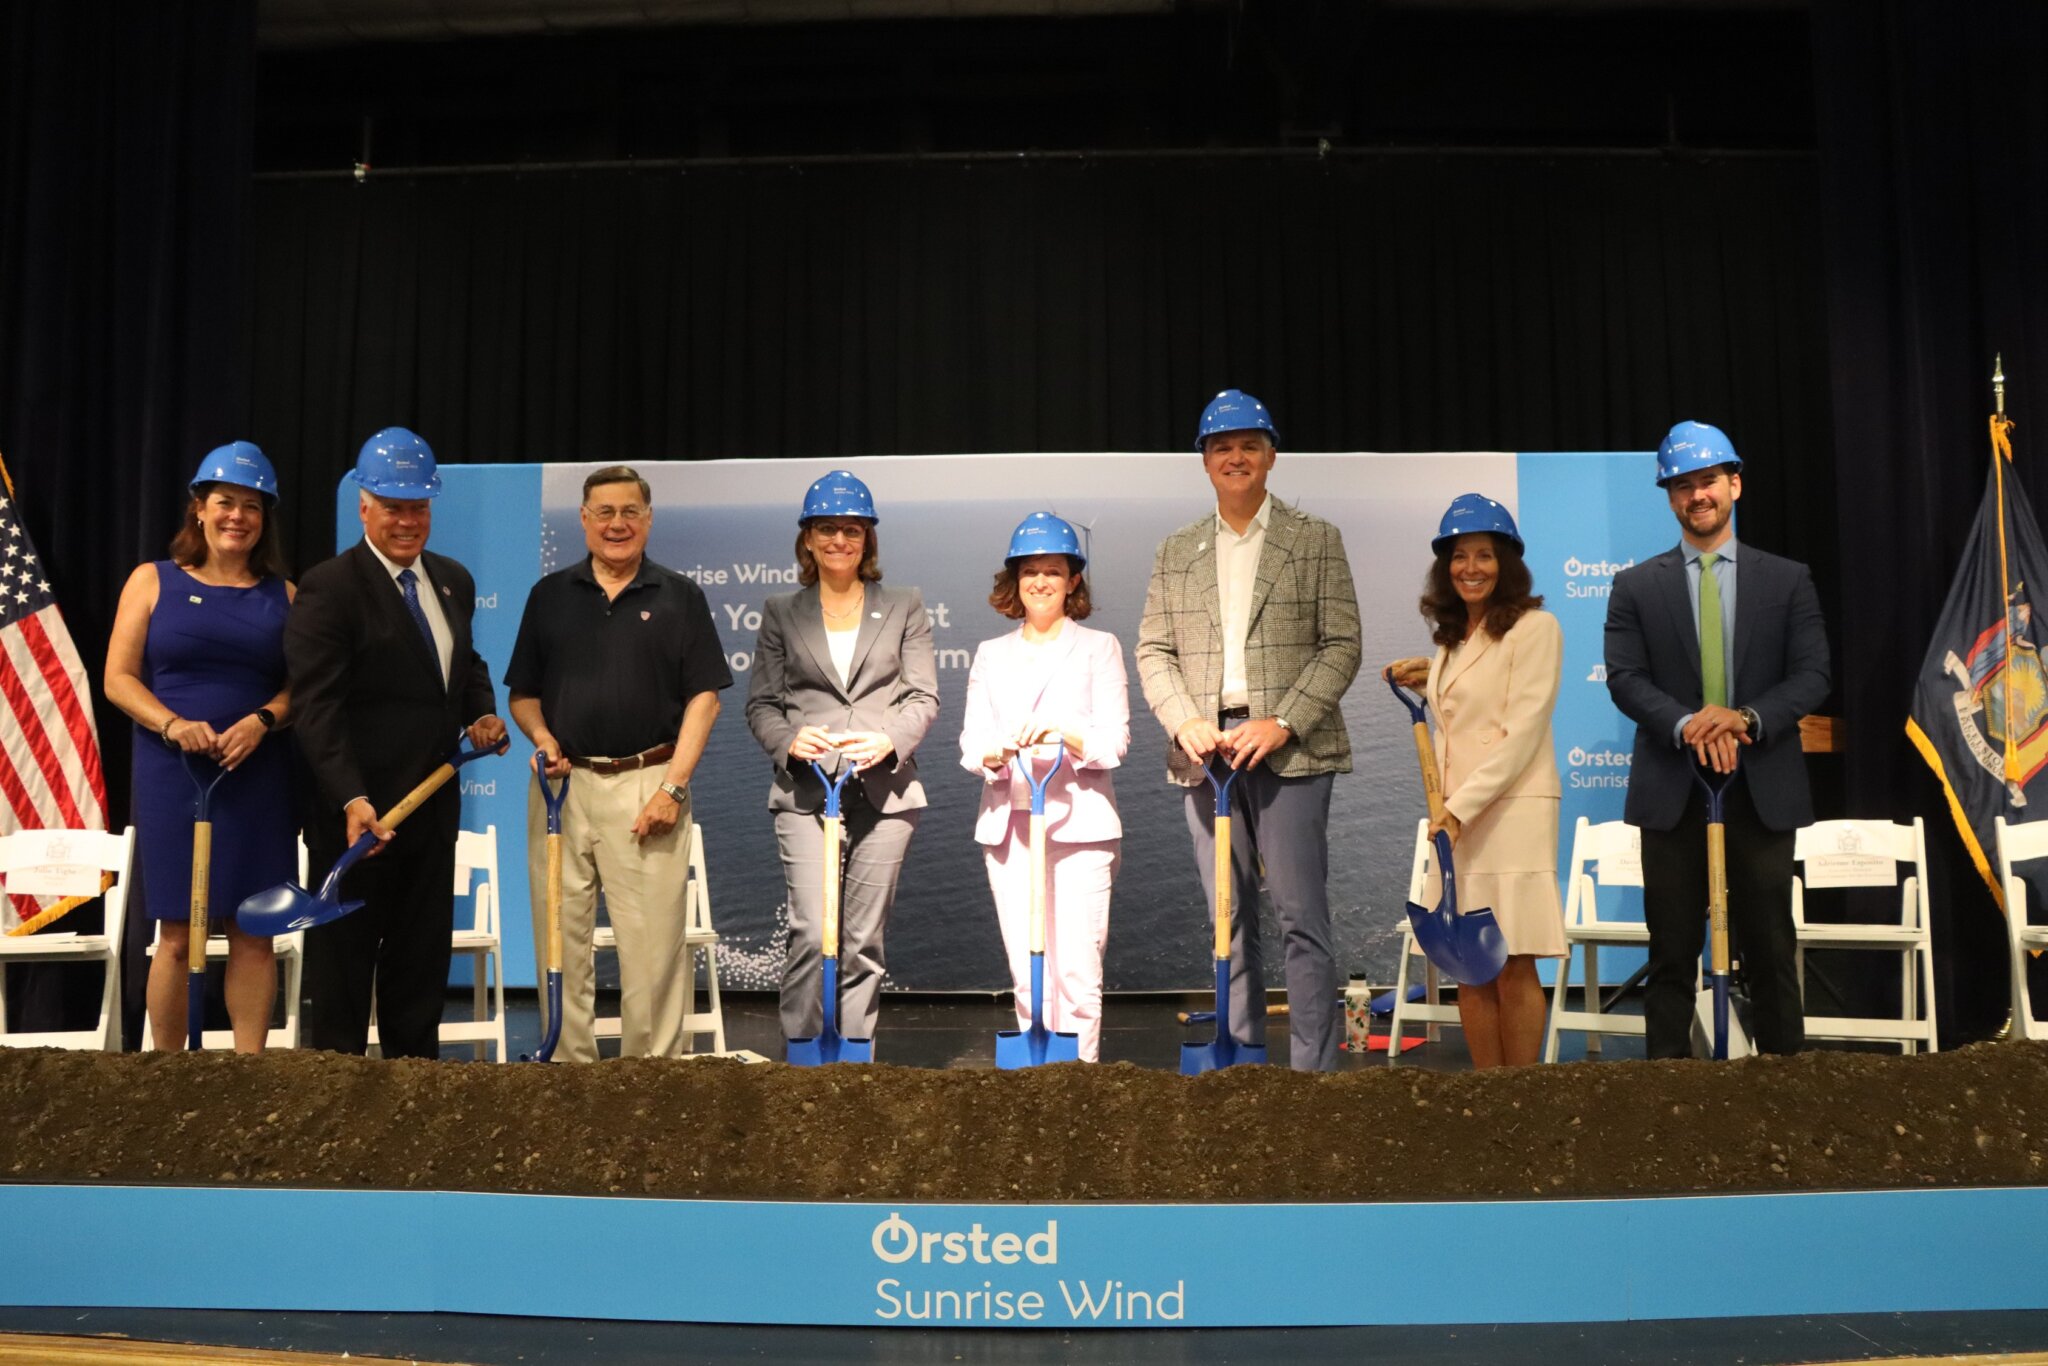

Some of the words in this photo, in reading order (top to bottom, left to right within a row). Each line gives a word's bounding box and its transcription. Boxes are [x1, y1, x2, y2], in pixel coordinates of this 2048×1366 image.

[676, 565, 729, 585] rise
[733, 563, 799, 584] Wind
[475, 592, 498, 609] nd
[1565, 581, 1614, 598] Sunri
[723, 603, 763, 631] Yo
[874, 1278, 1046, 1321] Sunrise
[1058, 1279, 1185, 1321] Wind
